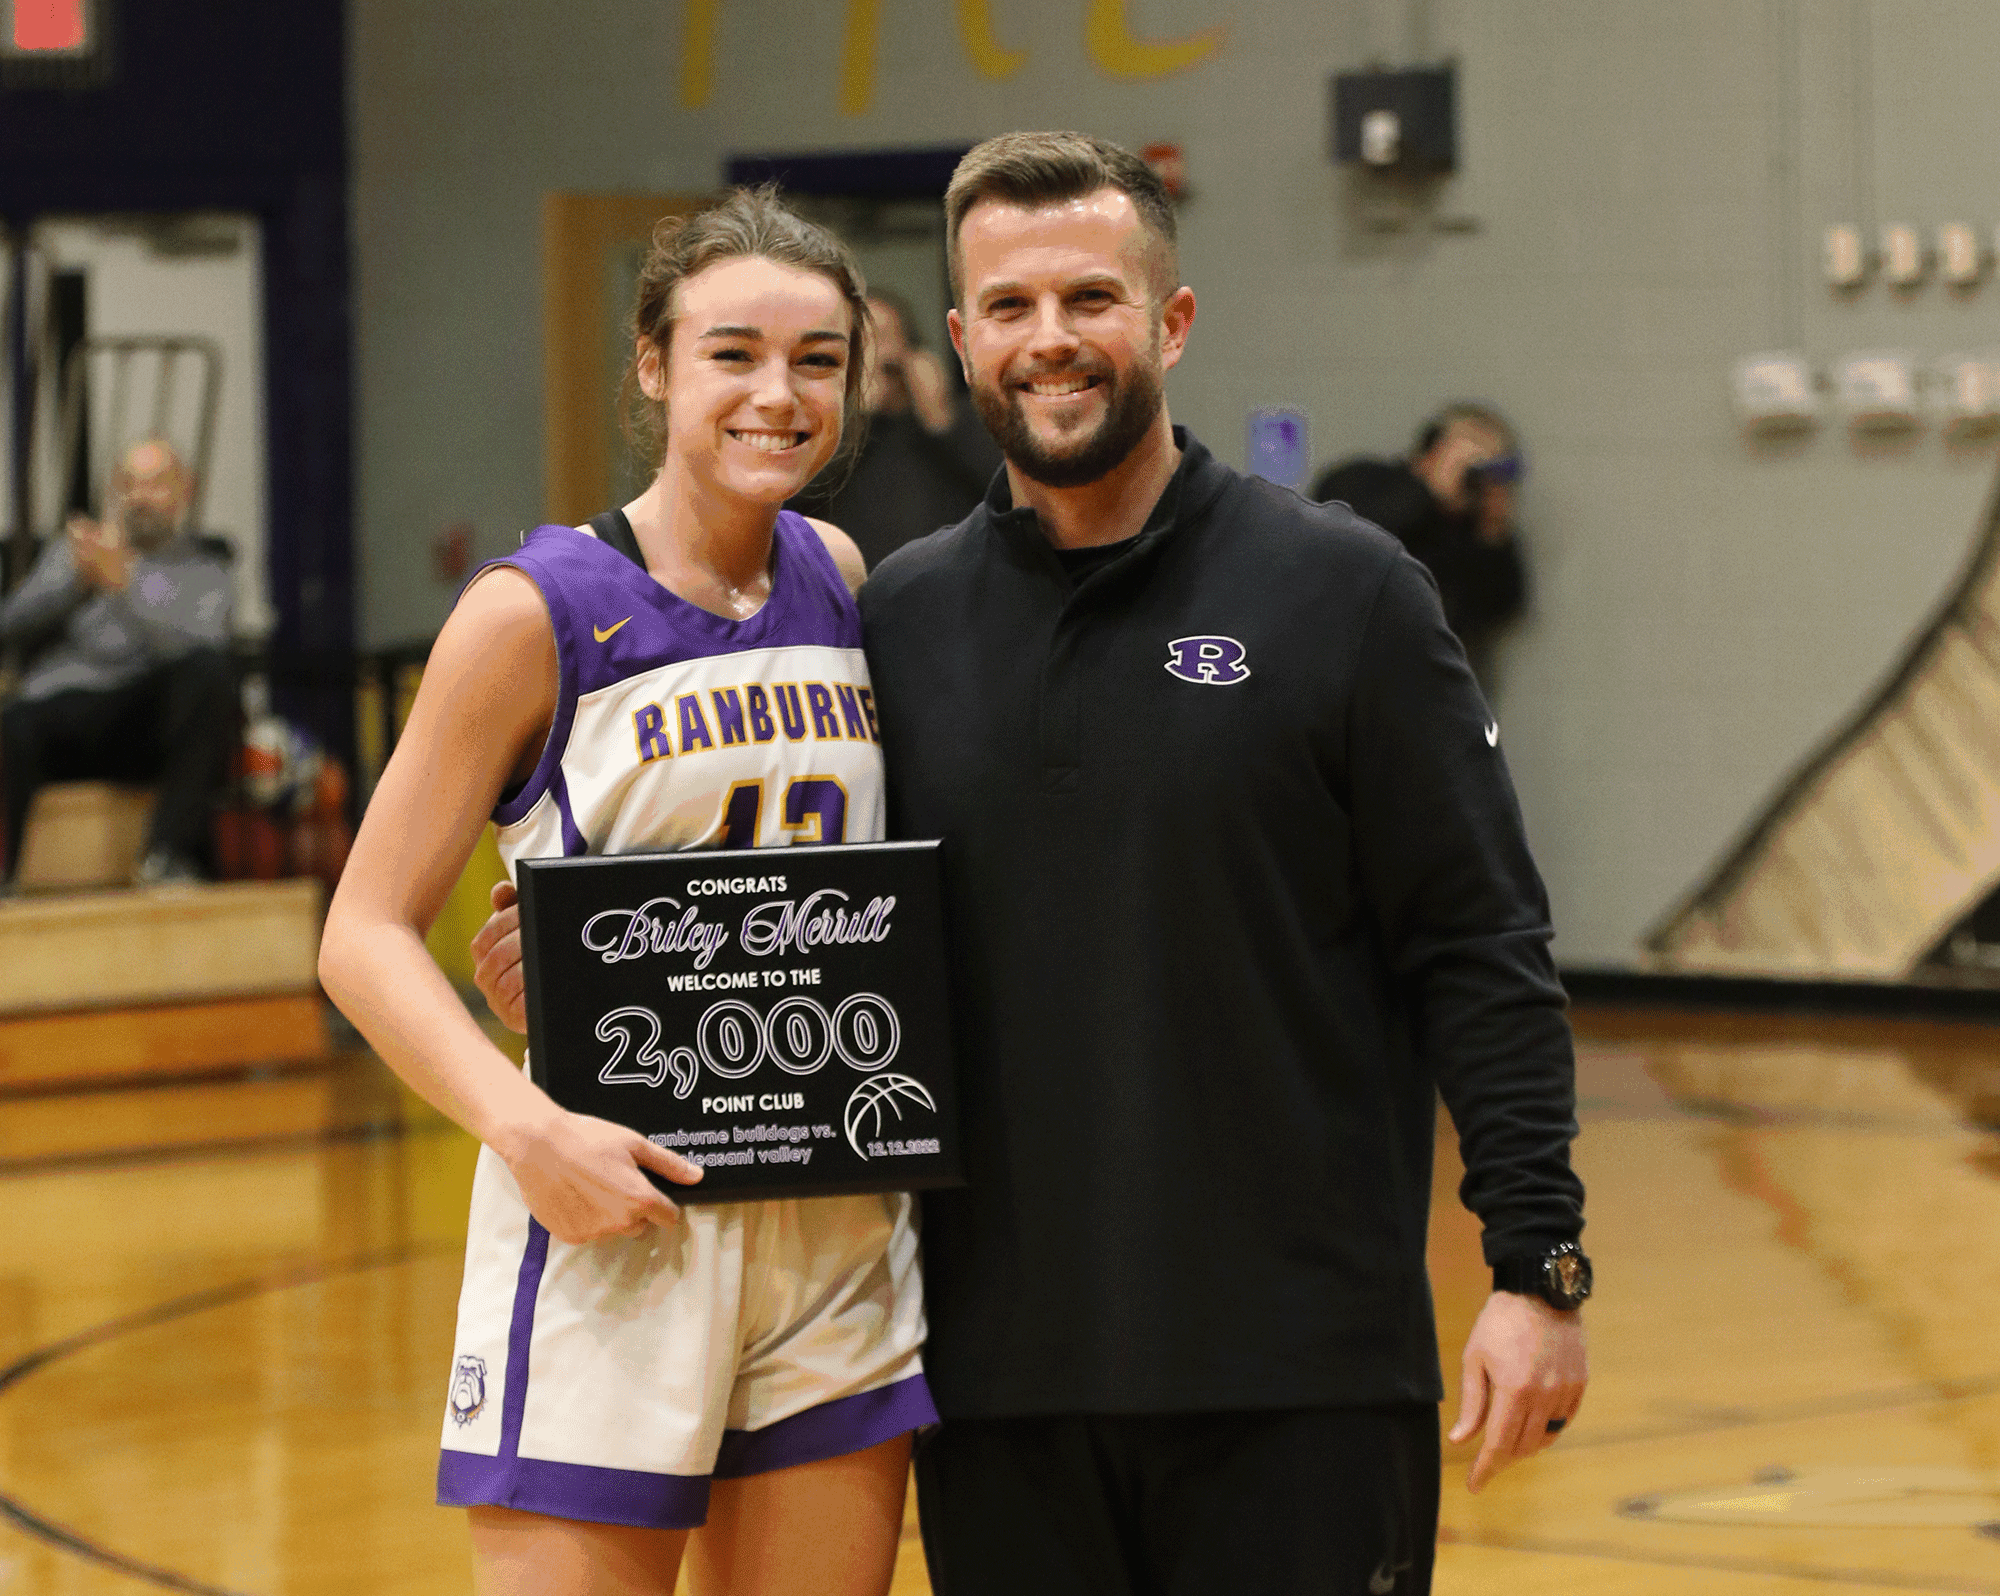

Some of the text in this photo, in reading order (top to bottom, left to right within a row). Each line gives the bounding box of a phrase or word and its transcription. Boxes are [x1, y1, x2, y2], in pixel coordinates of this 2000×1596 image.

[1164, 635, 1251, 685] R
[632, 681, 880, 766] RANBURNE
[686, 875, 788, 897] CONGRATS
[581, 888, 896, 970] Briley Merrill
[666, 968, 822, 993] WELCOME TO THE
[595, 992, 900, 1100] 2,000
[701, 1092, 805, 1115] POINT CLUB
[648, 1124, 837, 1147] ranburne bulldogs vs.
[757, 1145, 813, 1165] valley
